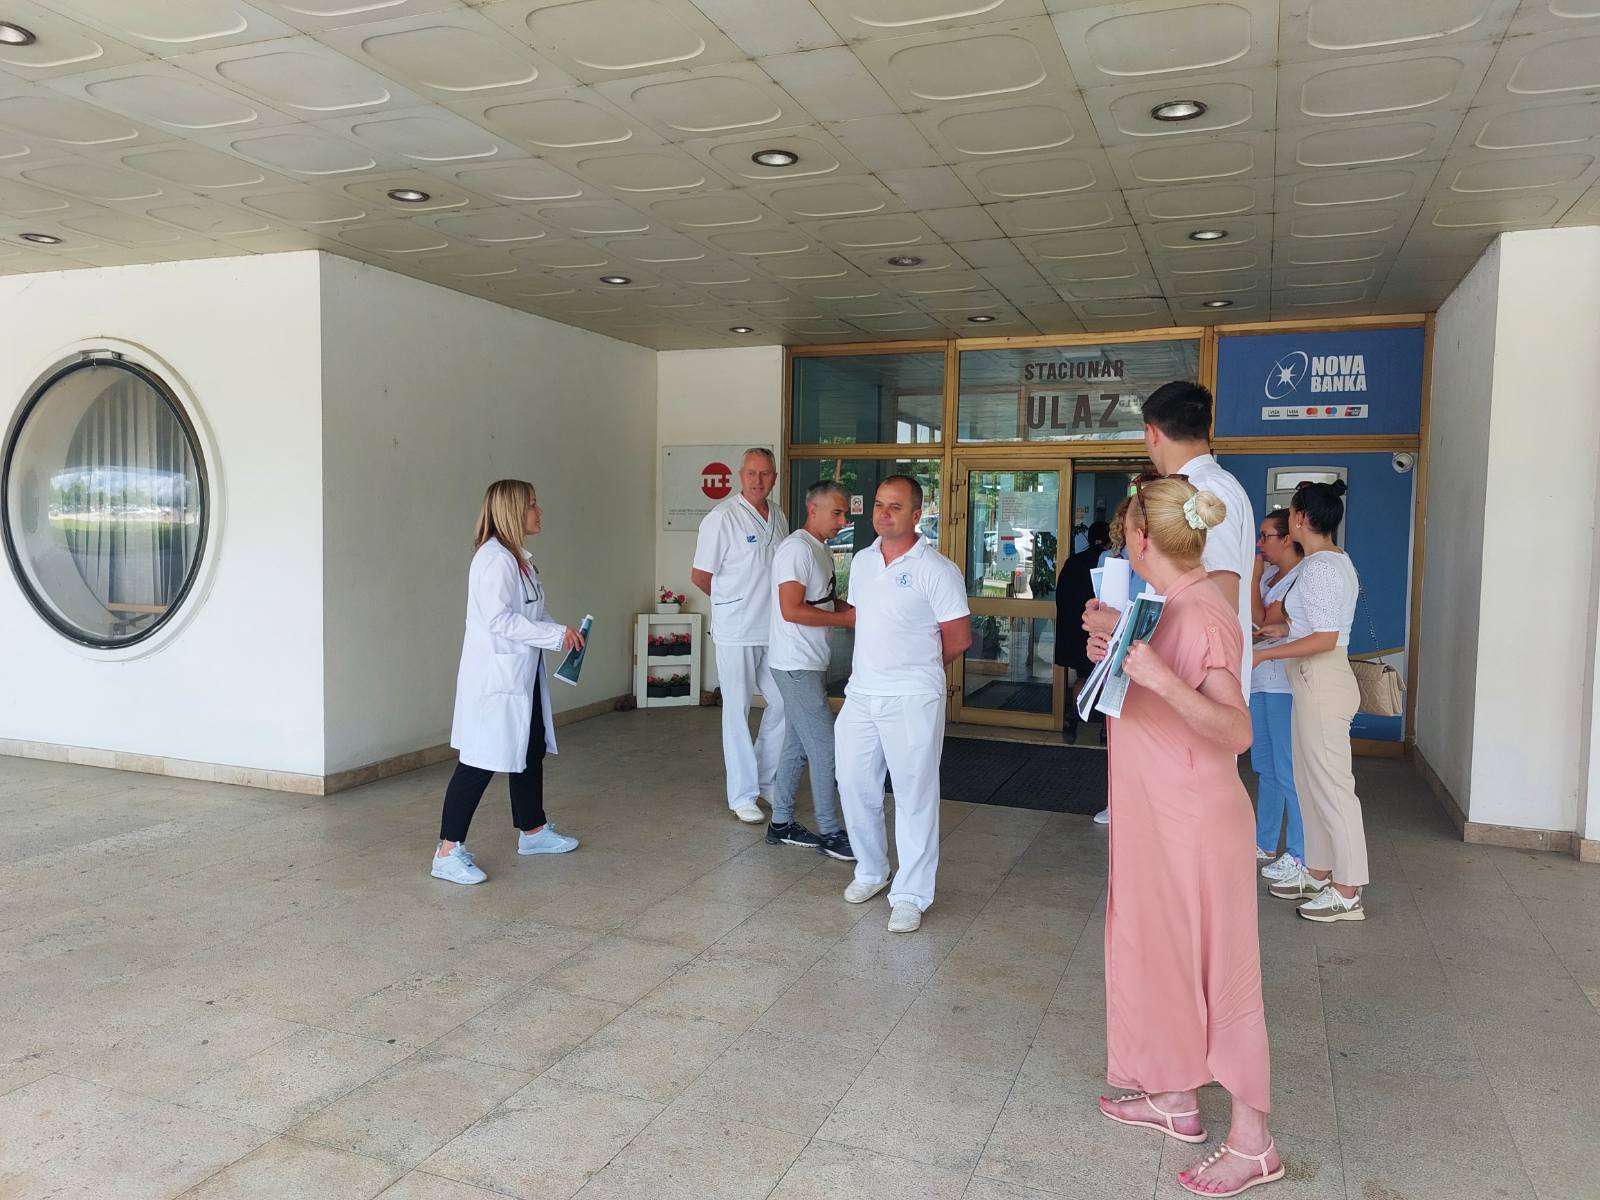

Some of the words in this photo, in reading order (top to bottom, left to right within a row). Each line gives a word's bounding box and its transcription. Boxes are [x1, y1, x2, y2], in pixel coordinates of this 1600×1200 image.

[1024, 359, 1124, 380] STACIONAR
[1311, 354, 1366, 376] NOVA
[1310, 375, 1367, 393] BANKA
[1026, 393, 1120, 429] ULAZ
